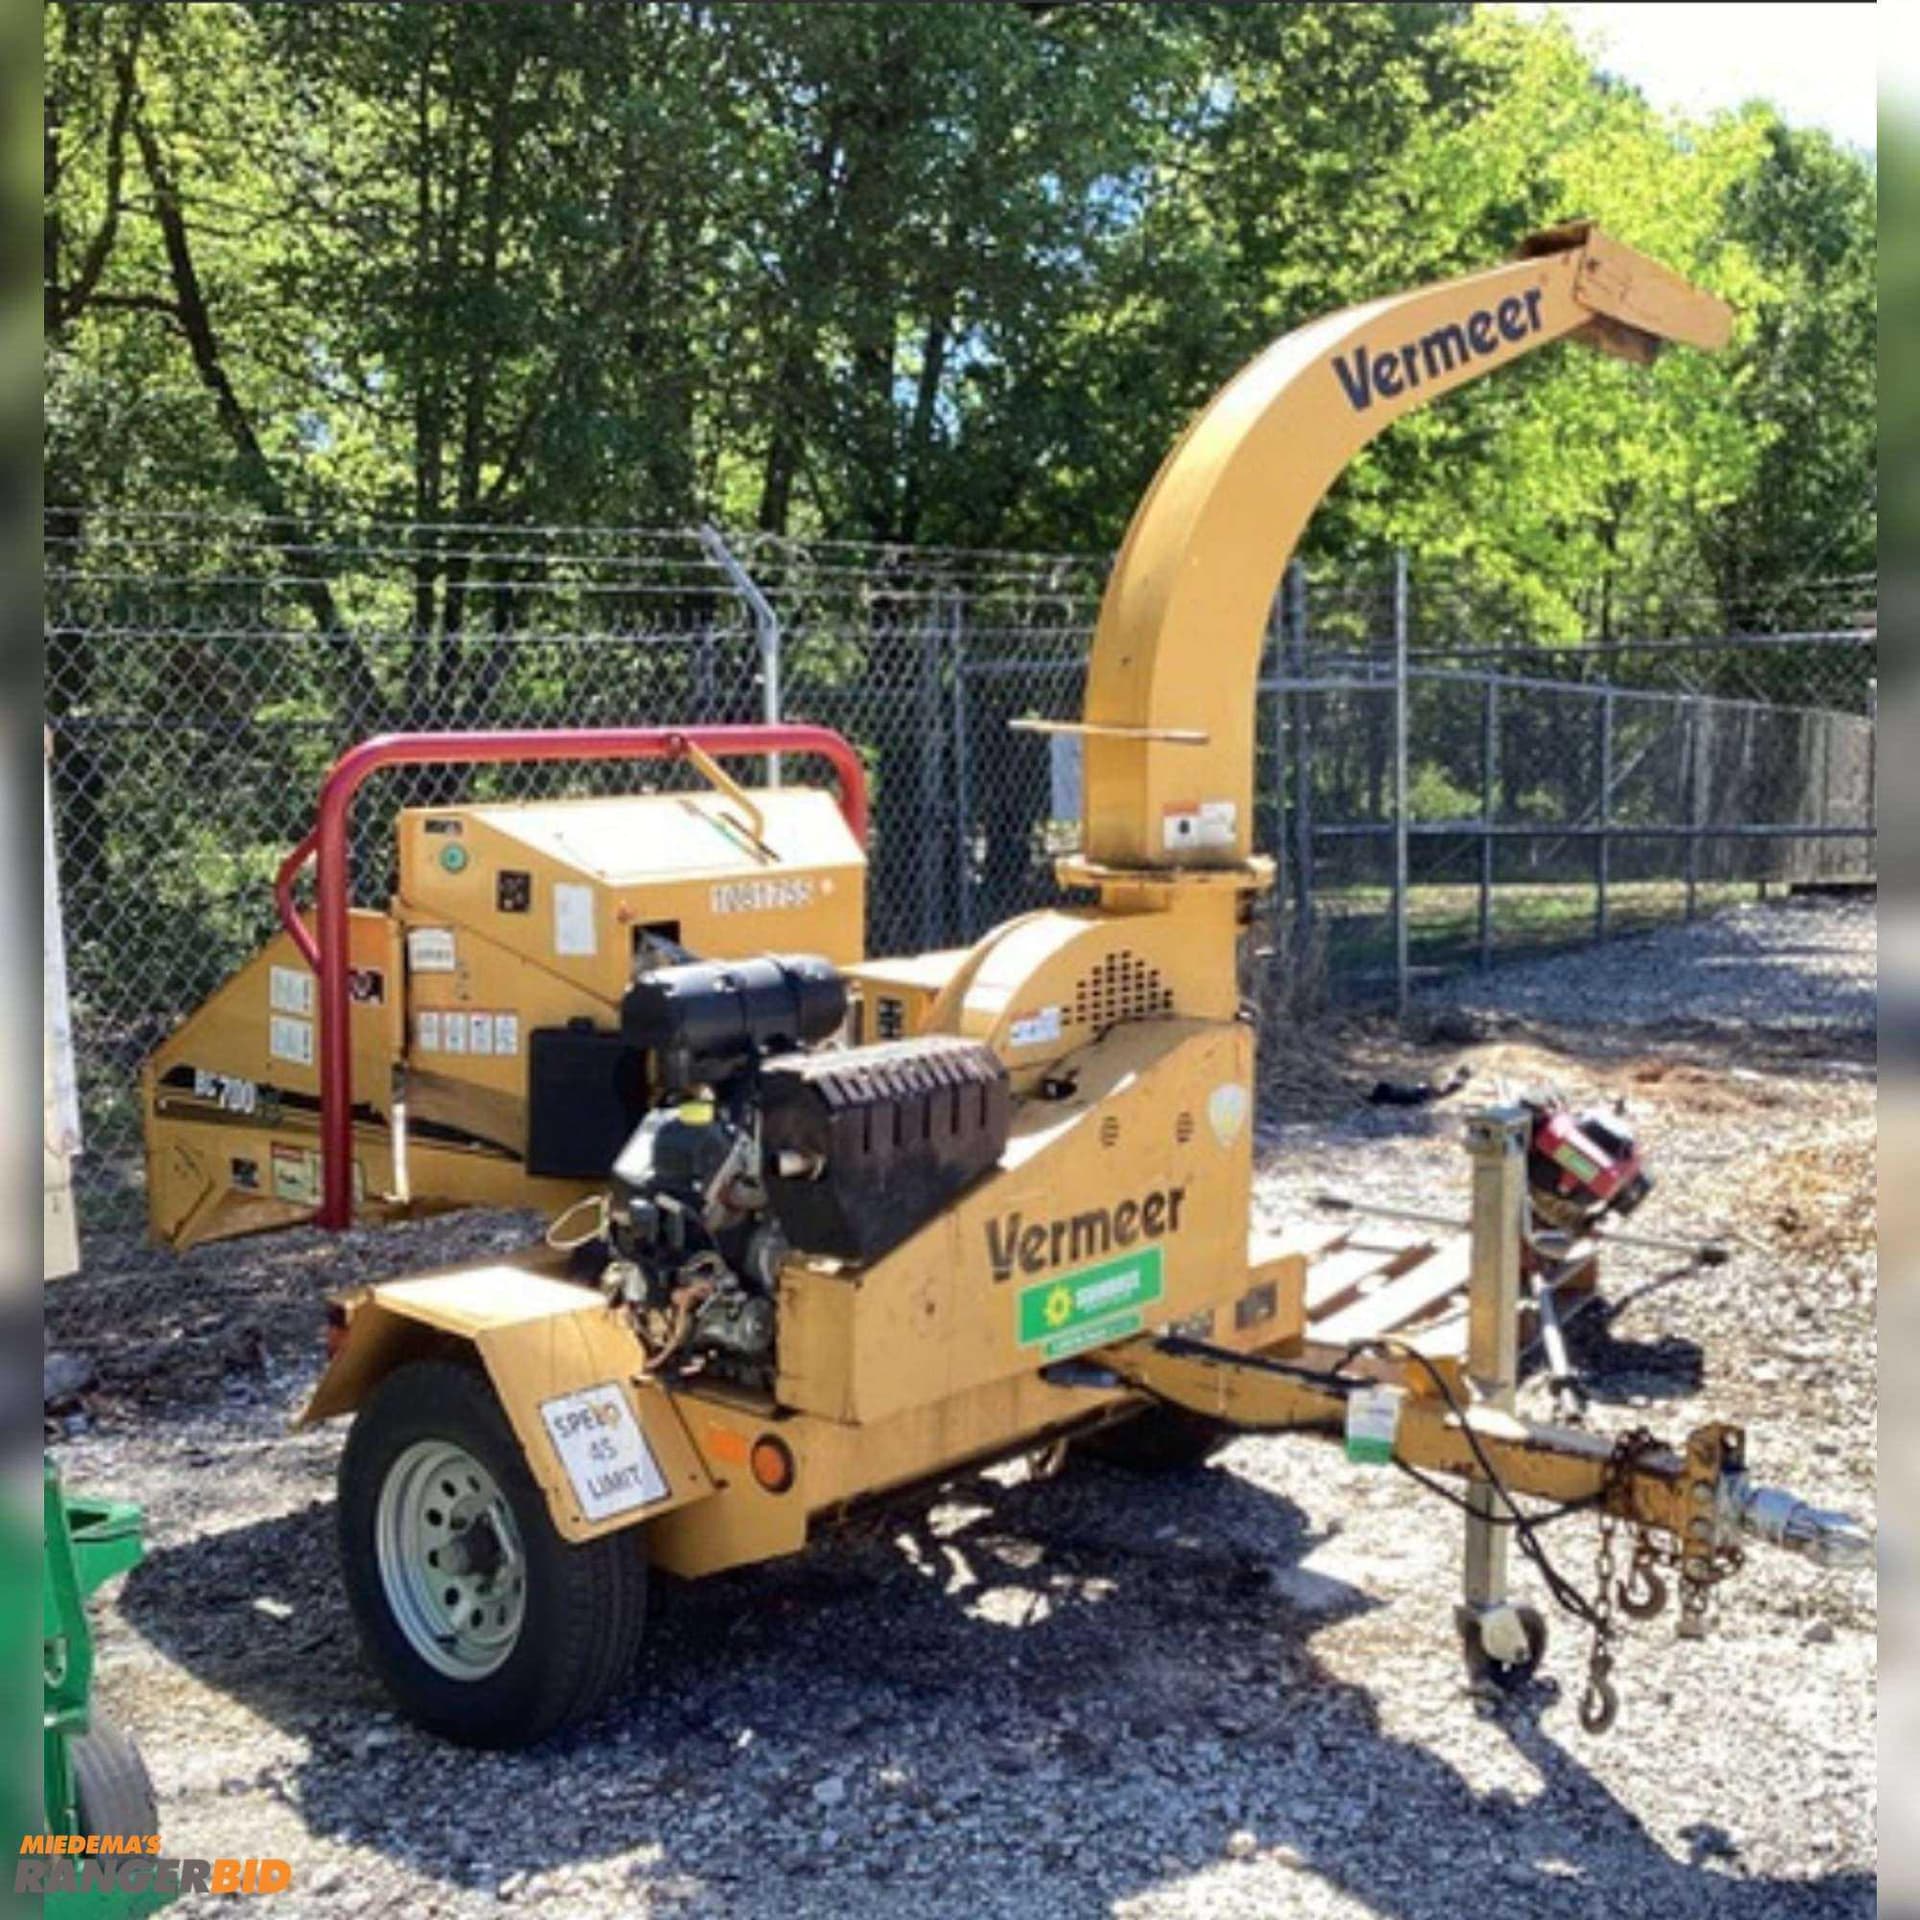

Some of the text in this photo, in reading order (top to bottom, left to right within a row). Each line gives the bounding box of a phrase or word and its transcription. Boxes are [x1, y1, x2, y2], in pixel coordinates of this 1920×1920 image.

[1333, 290, 1542, 411] Vermeer
[984, 1187, 1186, 1284] Vermeer
[587, 1464, 643, 1500] LIMIT
[591, 1438, 618, 1460] 45
